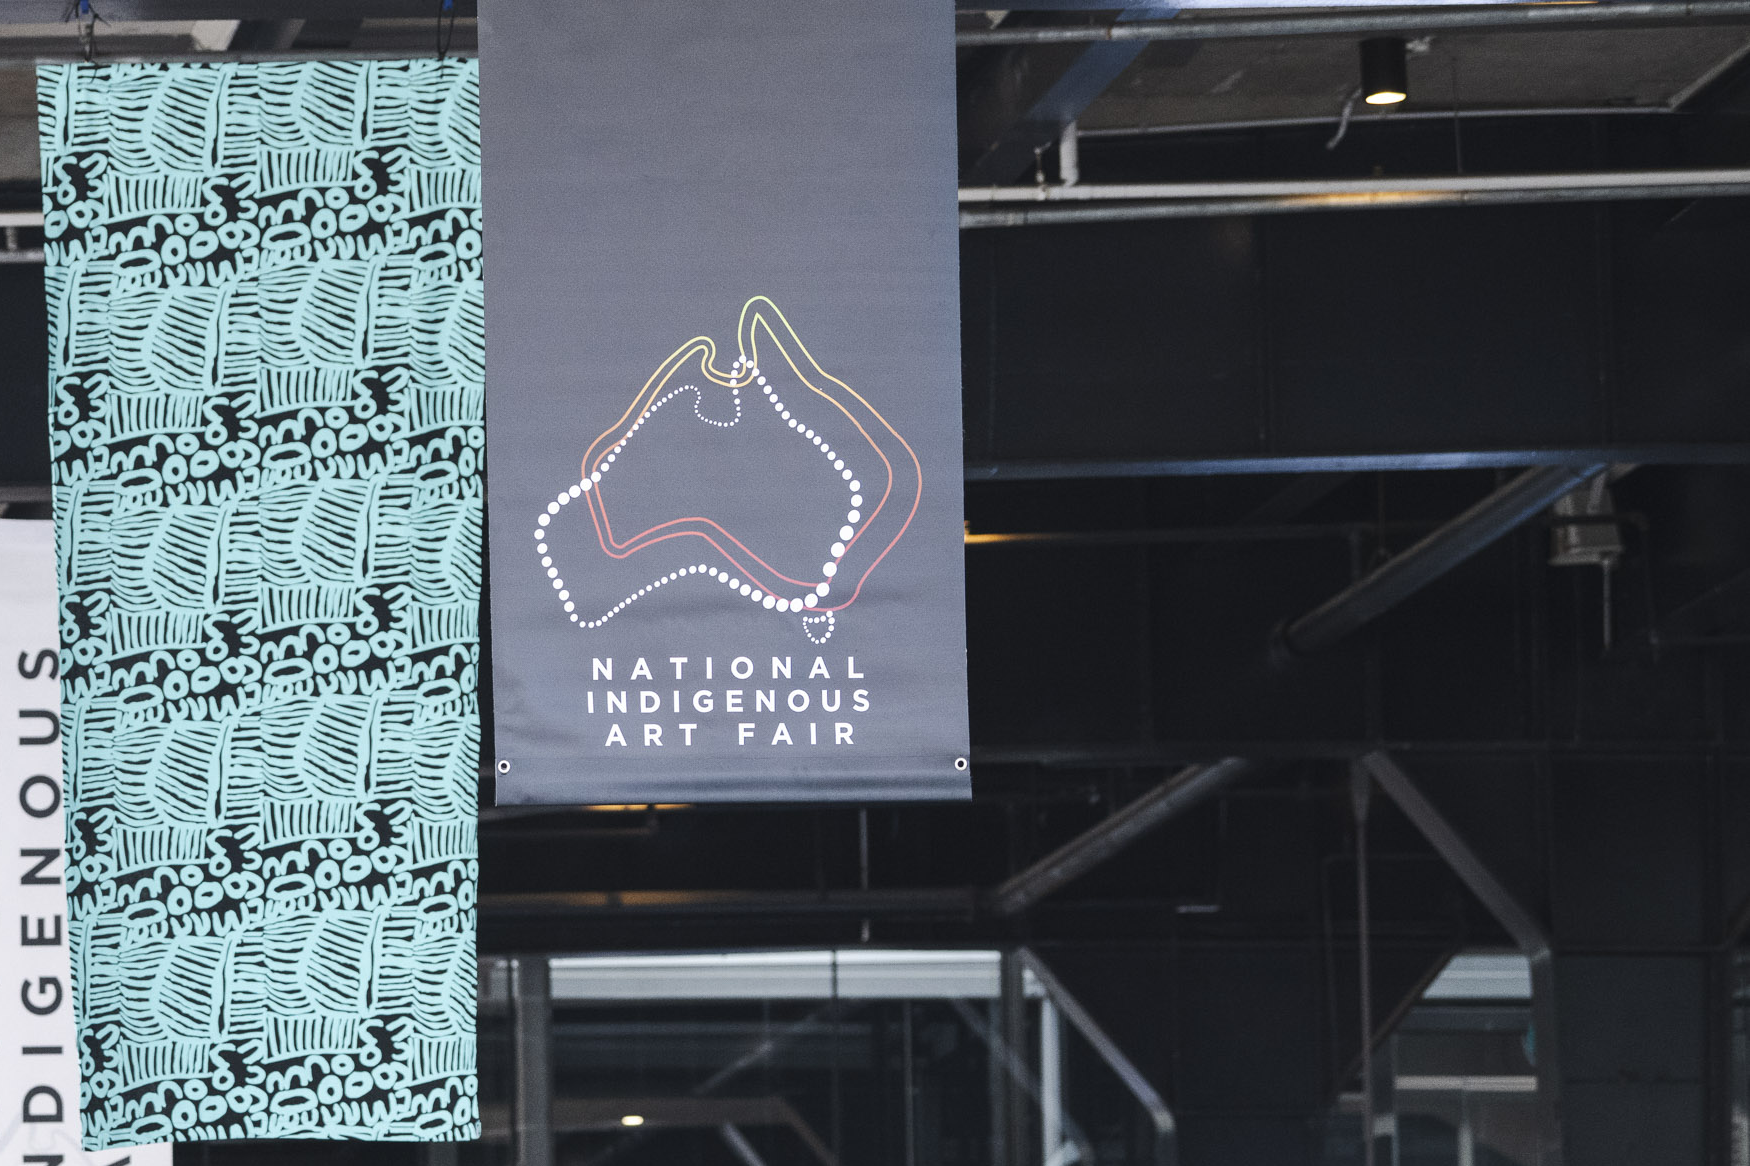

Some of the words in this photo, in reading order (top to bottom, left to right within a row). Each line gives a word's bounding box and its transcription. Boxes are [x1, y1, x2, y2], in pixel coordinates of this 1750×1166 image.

[592, 656, 865, 681] NATIONAL
[586, 688, 871, 714] INDIGENOUS
[604, 723, 698, 747] ART
[738, 722, 855, 746] FAIR
